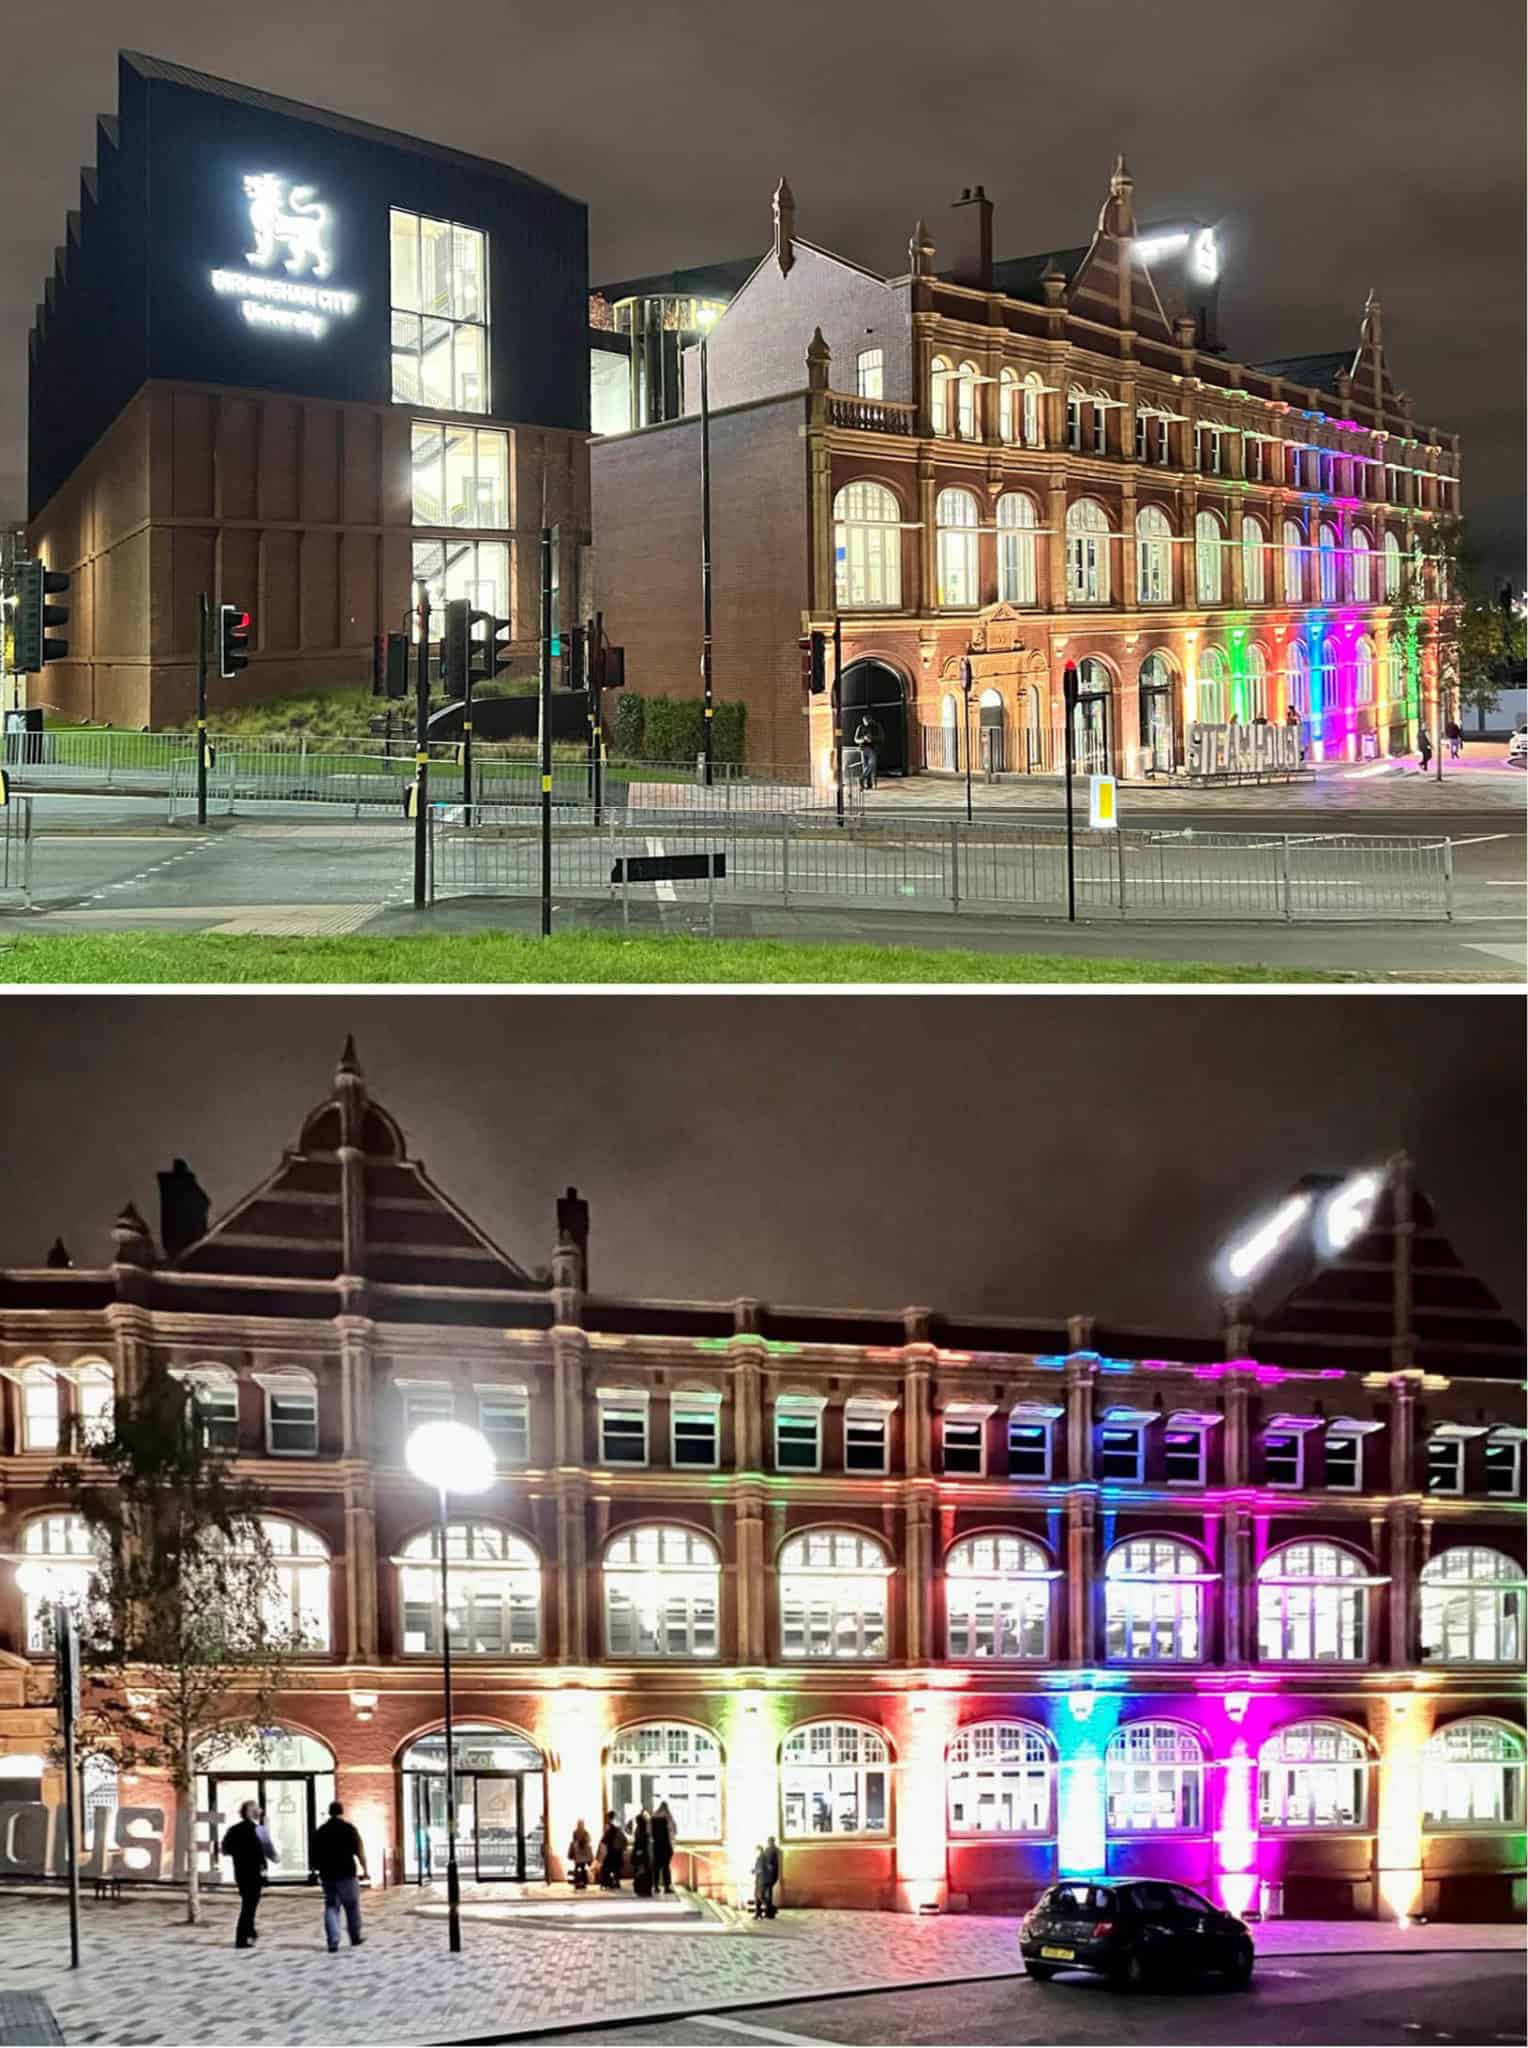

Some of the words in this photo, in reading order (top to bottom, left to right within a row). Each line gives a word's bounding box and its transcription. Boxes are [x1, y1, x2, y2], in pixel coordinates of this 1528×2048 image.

[211, 270, 317, 308] BIRMINGHAM
[317, 289, 356, 315] CITY
[241, 300, 326, 338] University
